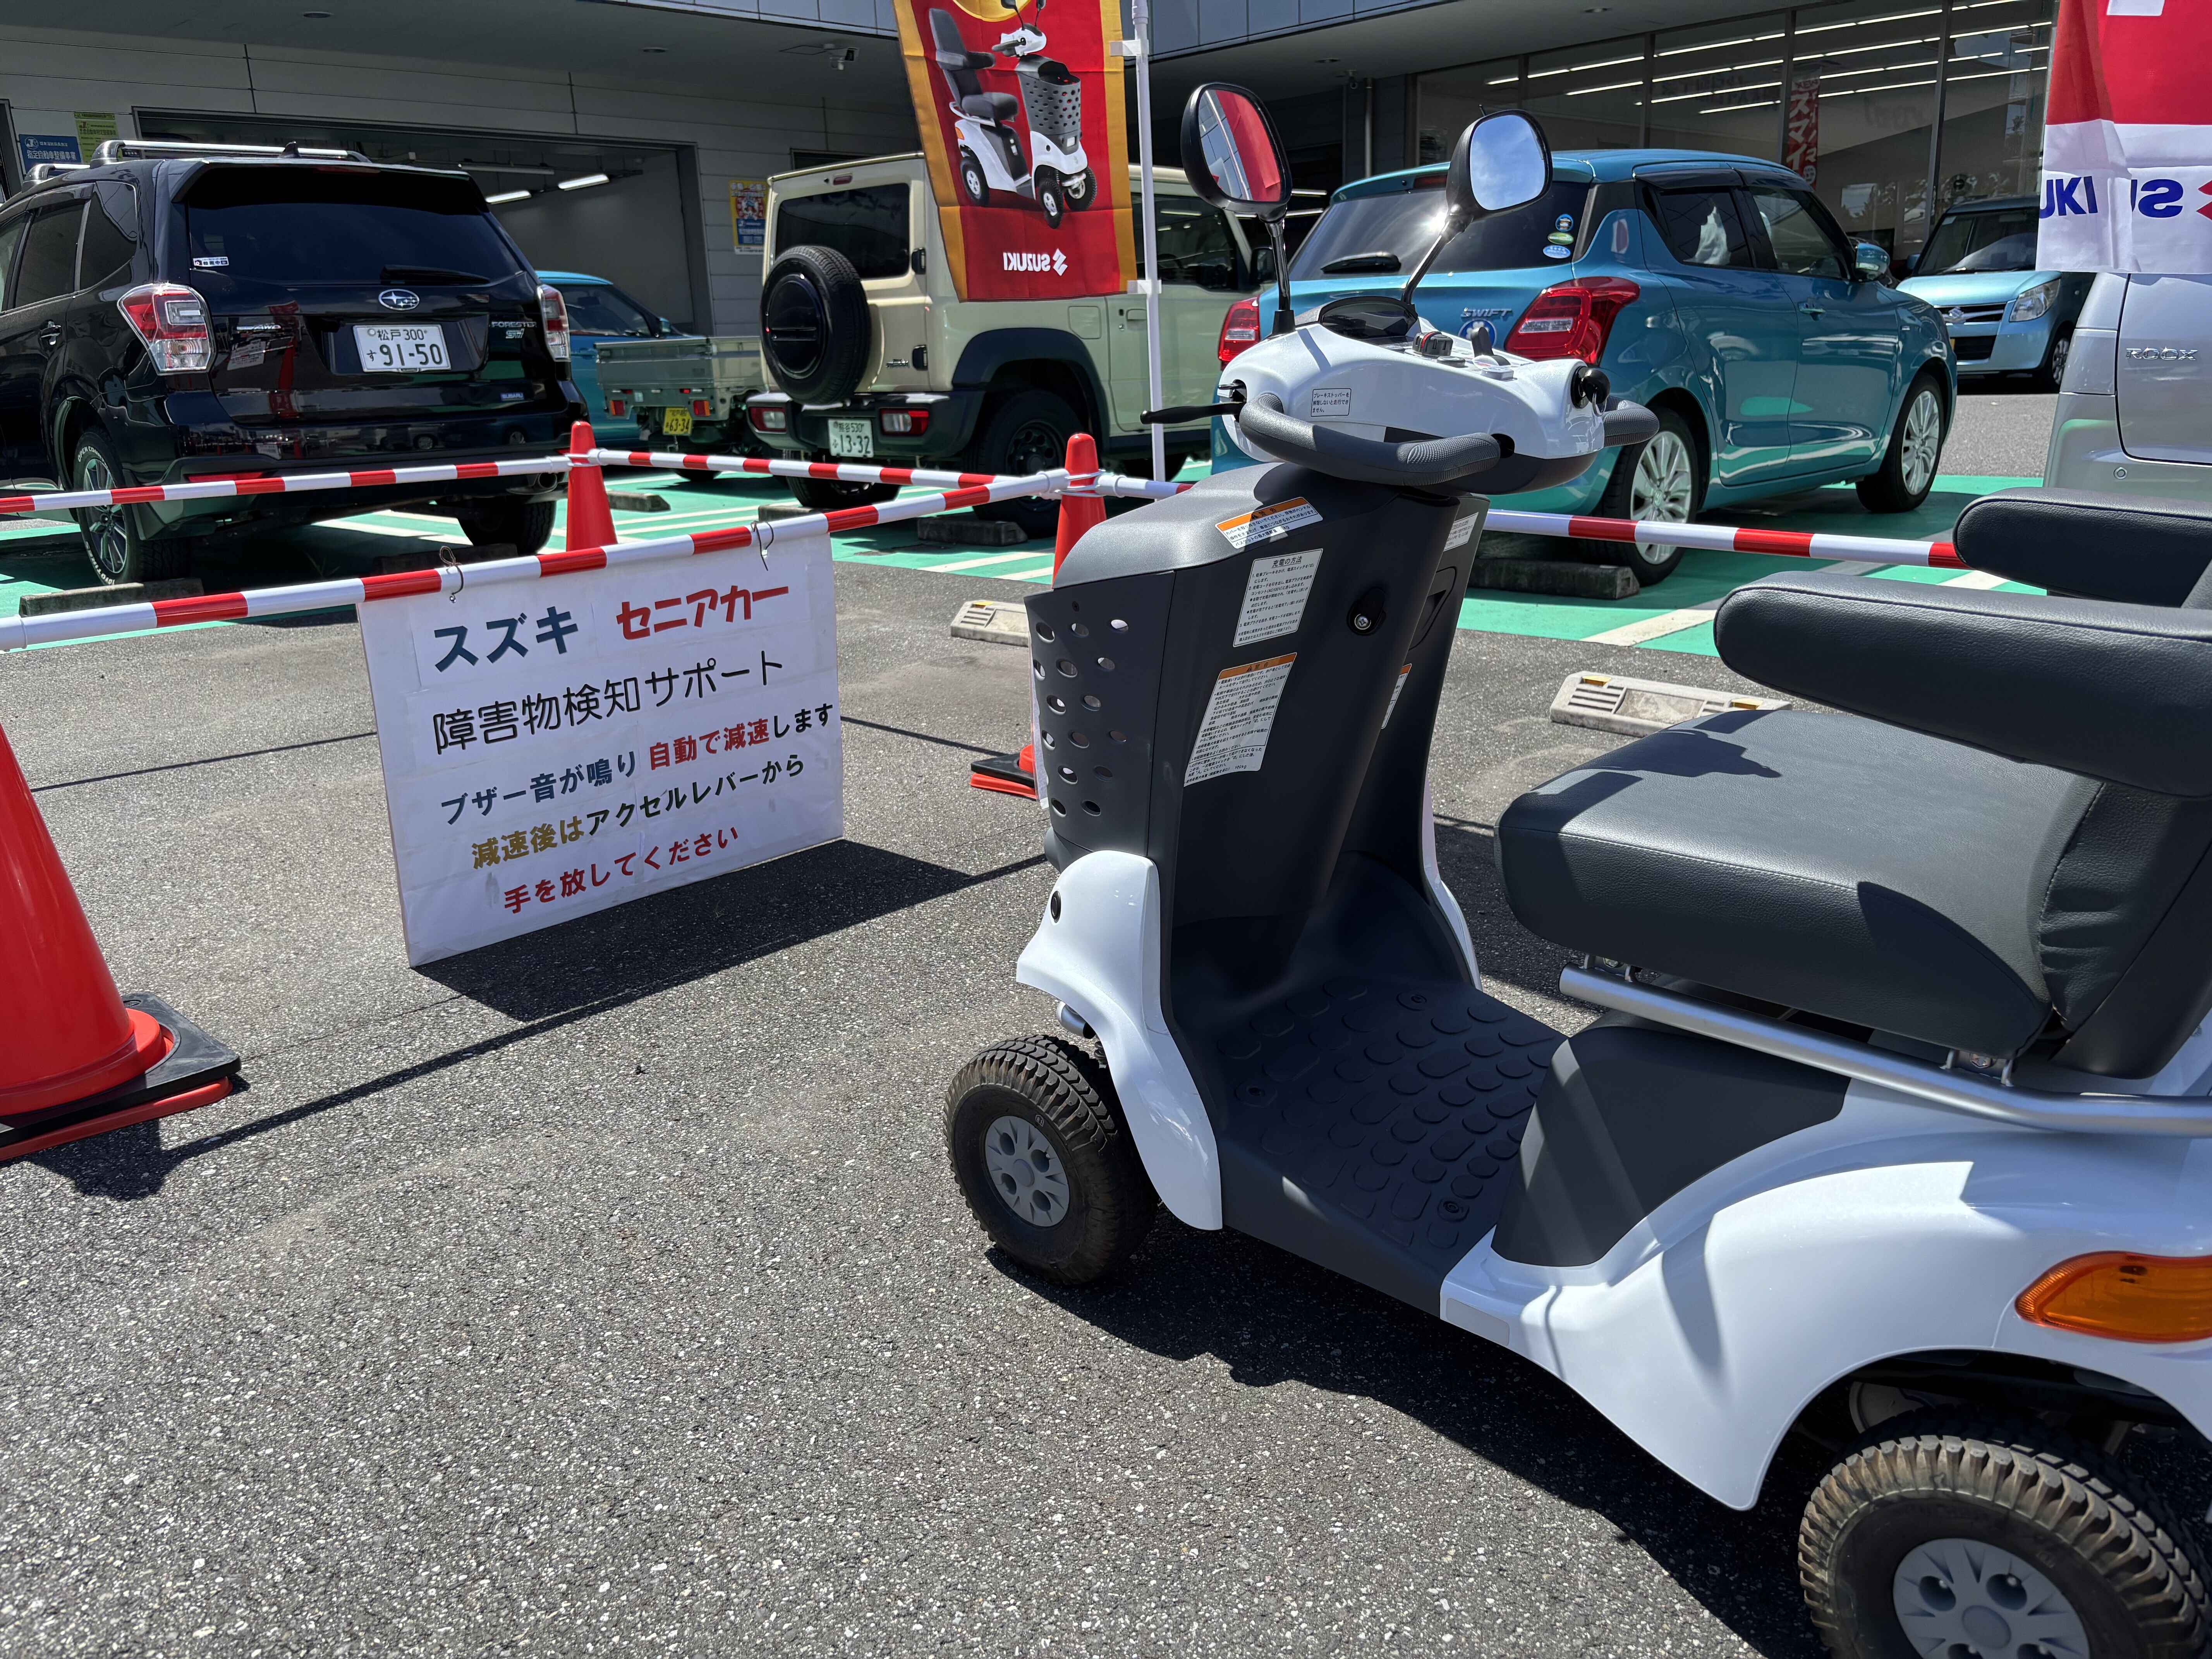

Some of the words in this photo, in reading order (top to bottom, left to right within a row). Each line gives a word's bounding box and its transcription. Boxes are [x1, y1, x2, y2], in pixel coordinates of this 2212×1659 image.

[377, 329, 401, 340] 松戸
[403, 329, 424, 340] 300
[1461, 307, 1512, 317] SWIFT
[366, 350, 377, 361] す
[380, 343, 443, 366] 91-50
[2125, 347, 2198, 361] ROOX
[1272, 555, 1303, 567] 充電の方法
[434, 606, 579, 672] スズキ
[616, 586, 789, 641] セニアカー
[434, 650, 783, 754] 障害物検知サポート
[441, 752, 637, 824] ブザー音が鳴り
[649, 703, 833, 771] 自動で減速します
[471, 754, 804, 869] 減速後はアクセルレバーから
[503, 826, 738, 914] 手を放してください
